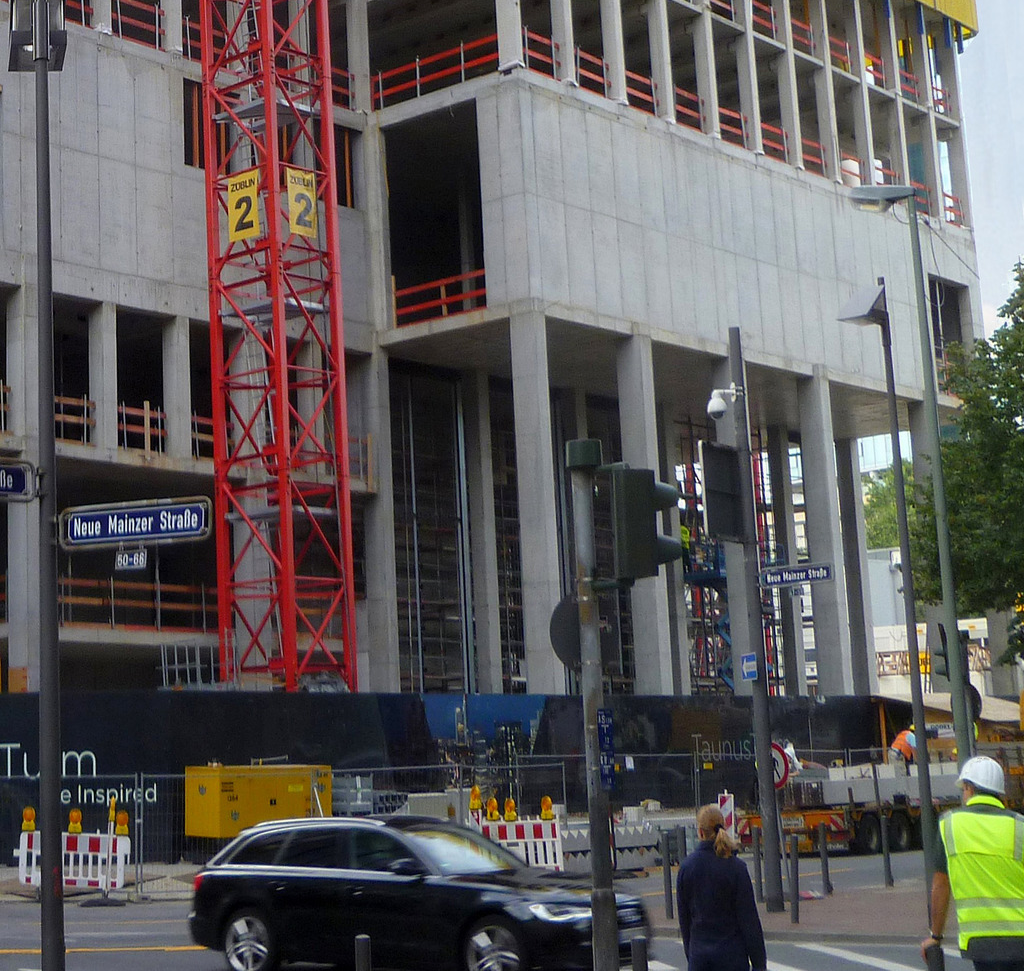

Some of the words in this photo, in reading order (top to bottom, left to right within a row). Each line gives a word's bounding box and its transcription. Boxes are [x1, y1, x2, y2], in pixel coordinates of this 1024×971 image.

[234, 195, 254, 233] 2
[294, 192, 313, 229] 2
[73, 517, 101, 538] Neue
[108, 513, 154, 535] Mainzer
[160, 508, 198, 530] Straße
